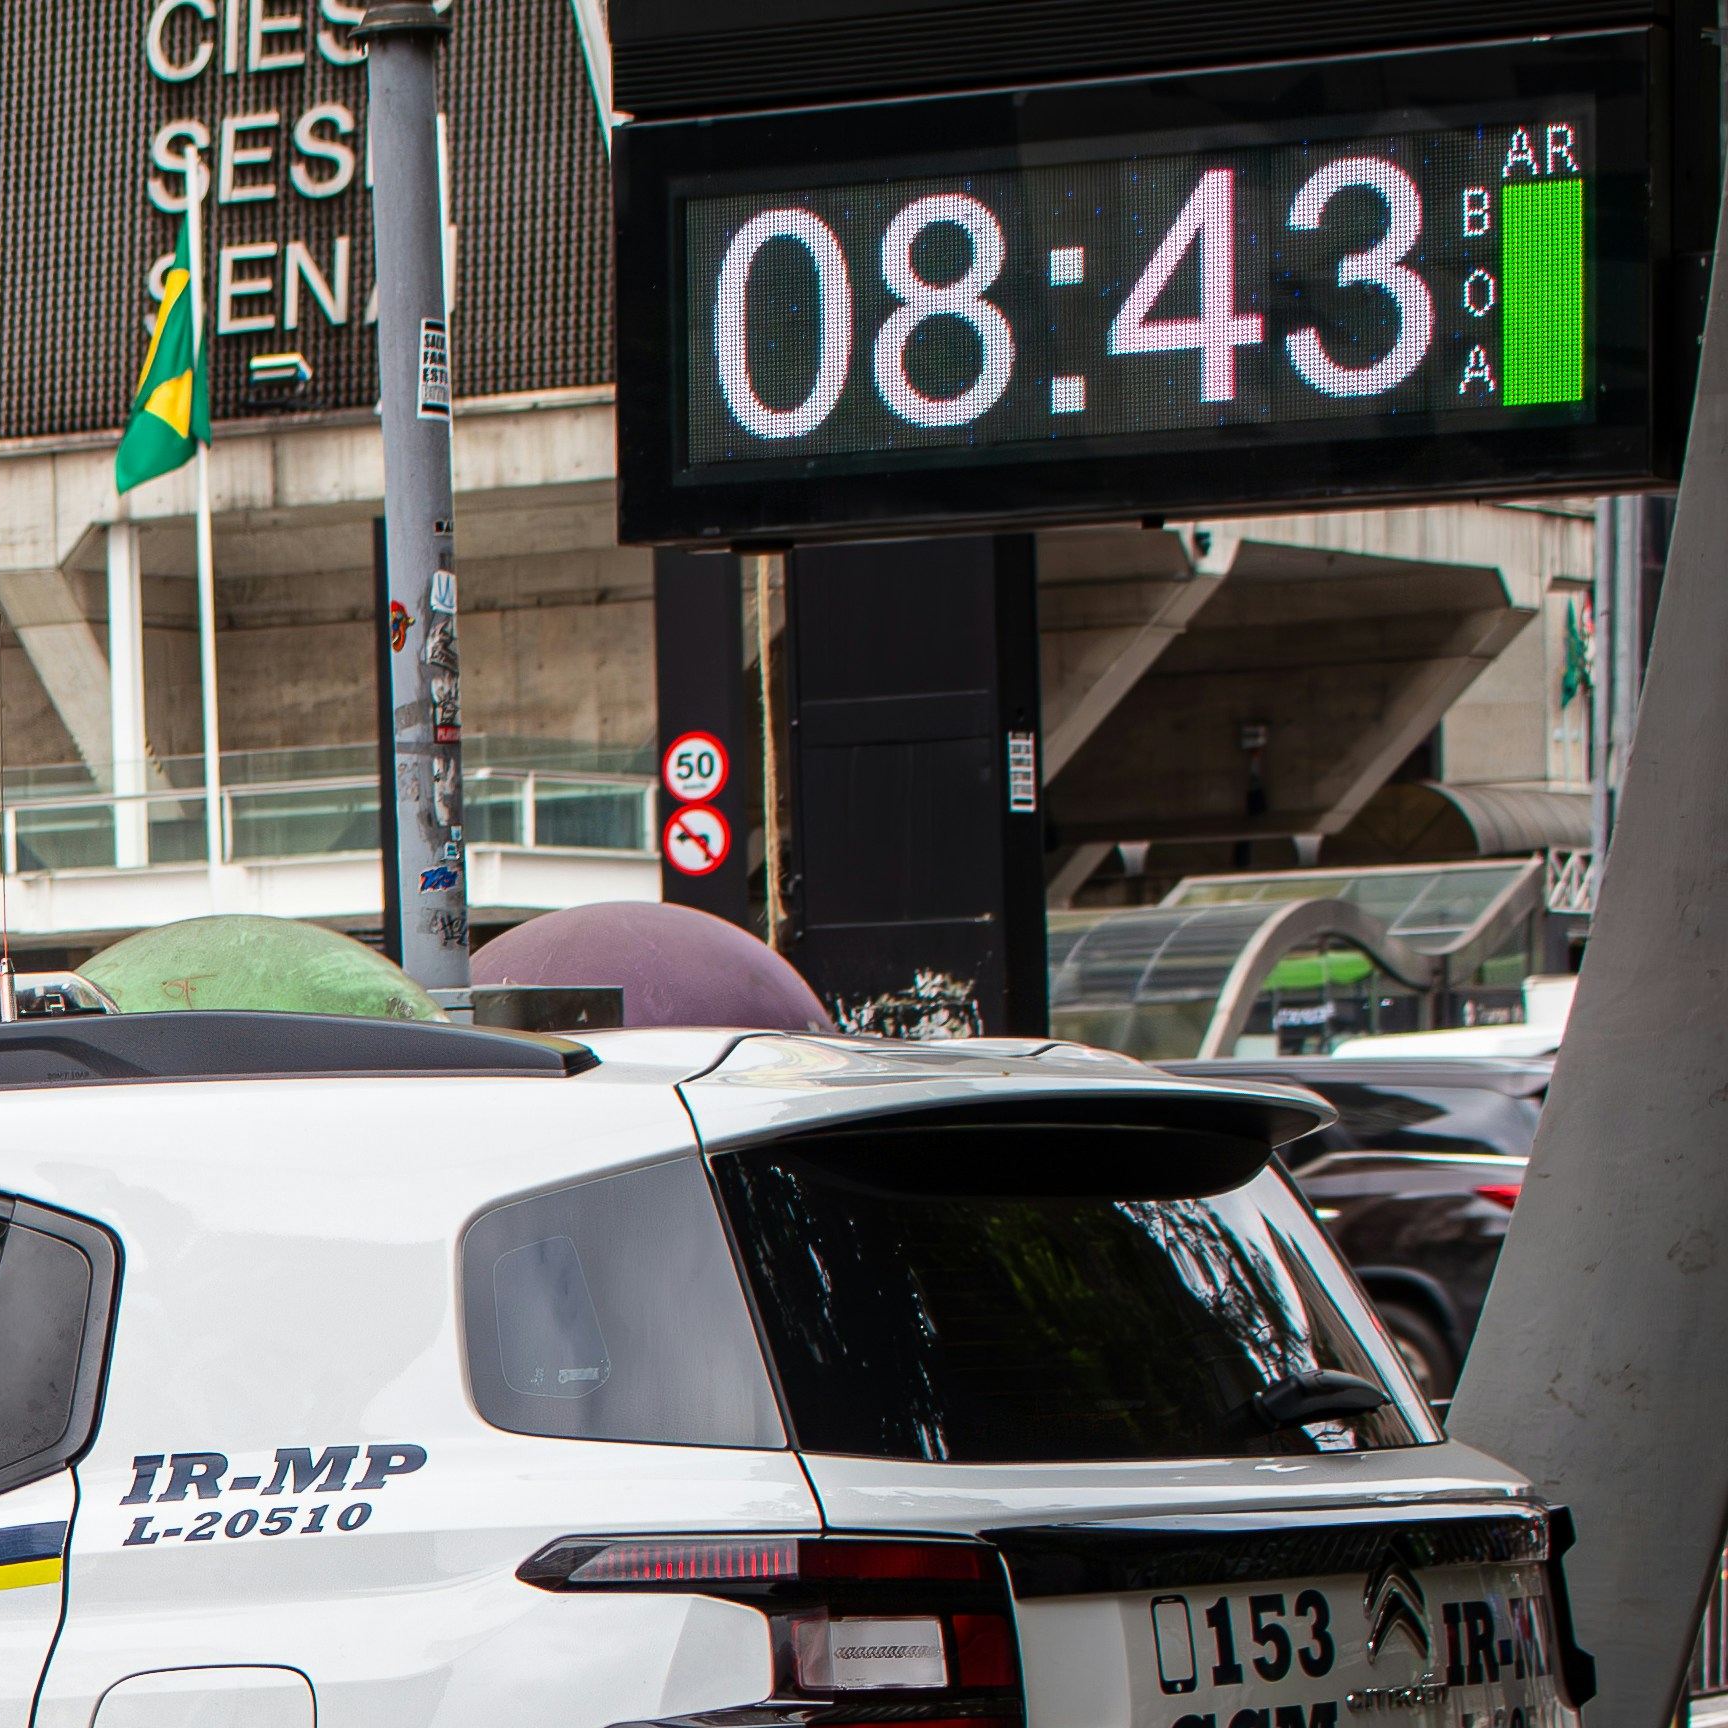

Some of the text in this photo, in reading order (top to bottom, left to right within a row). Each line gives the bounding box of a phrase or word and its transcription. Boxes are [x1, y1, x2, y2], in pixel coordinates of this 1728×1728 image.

[146, 0, 370, 81] CIES
[1502, 122, 1580, 178] AR
[714, 155, 1434, 438] 08:43
[676, 751, 715, 779] 50
[119, 1444, 427, 1505] IR-MP
[122, 1502, 373, 1546] L-20510
[1205, 1589, 1336, 1688] 153
